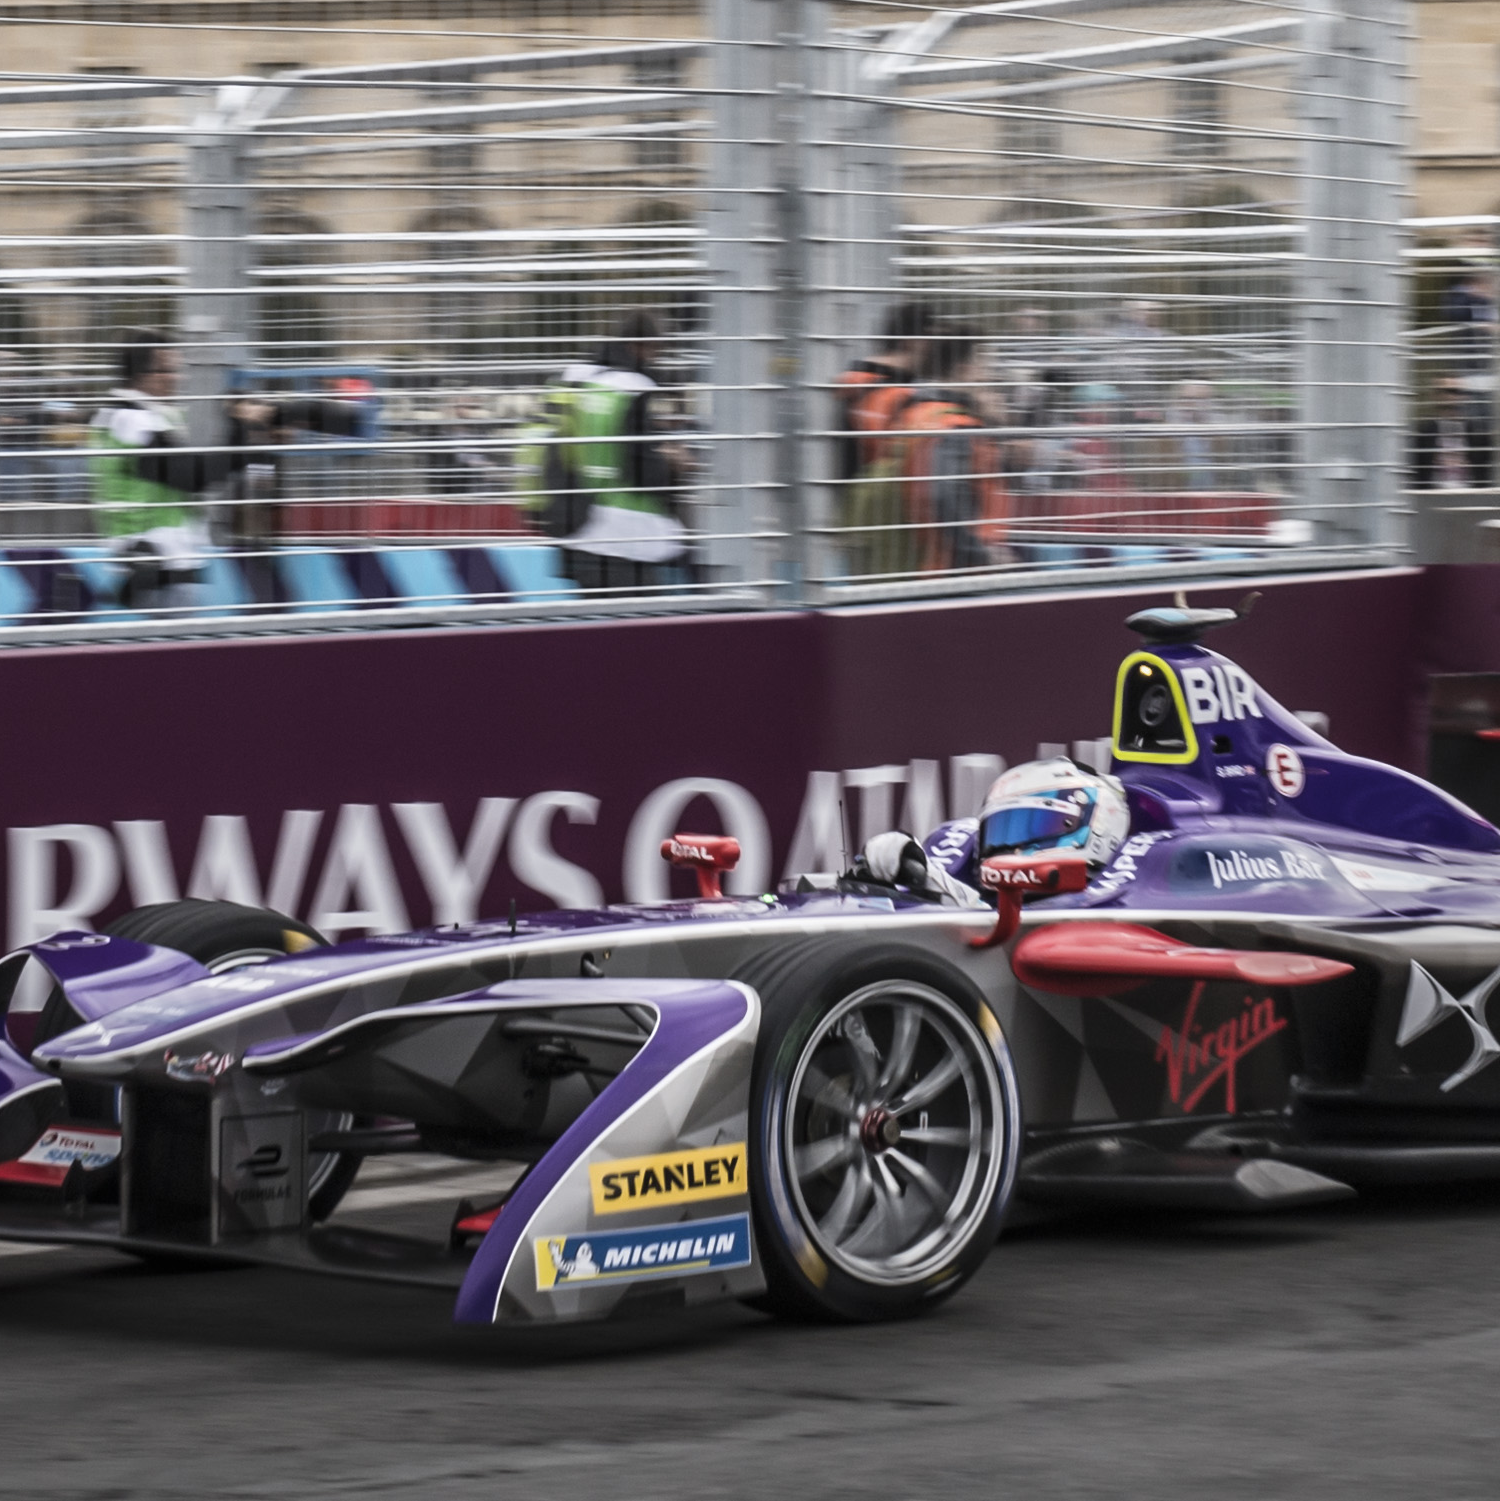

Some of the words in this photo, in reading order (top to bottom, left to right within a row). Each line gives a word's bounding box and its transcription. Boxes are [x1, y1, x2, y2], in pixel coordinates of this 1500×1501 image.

[1181, 664, 1263, 724] BIR
[980, 866, 1042, 885] TOTAL
[1204, 850, 1283, 889] Julius
[1154, 980, 1289, 1116] Virgin
[601, 1156, 740, 1201] STANLEY
[602, 1232, 736, 1269] MICHELIN
